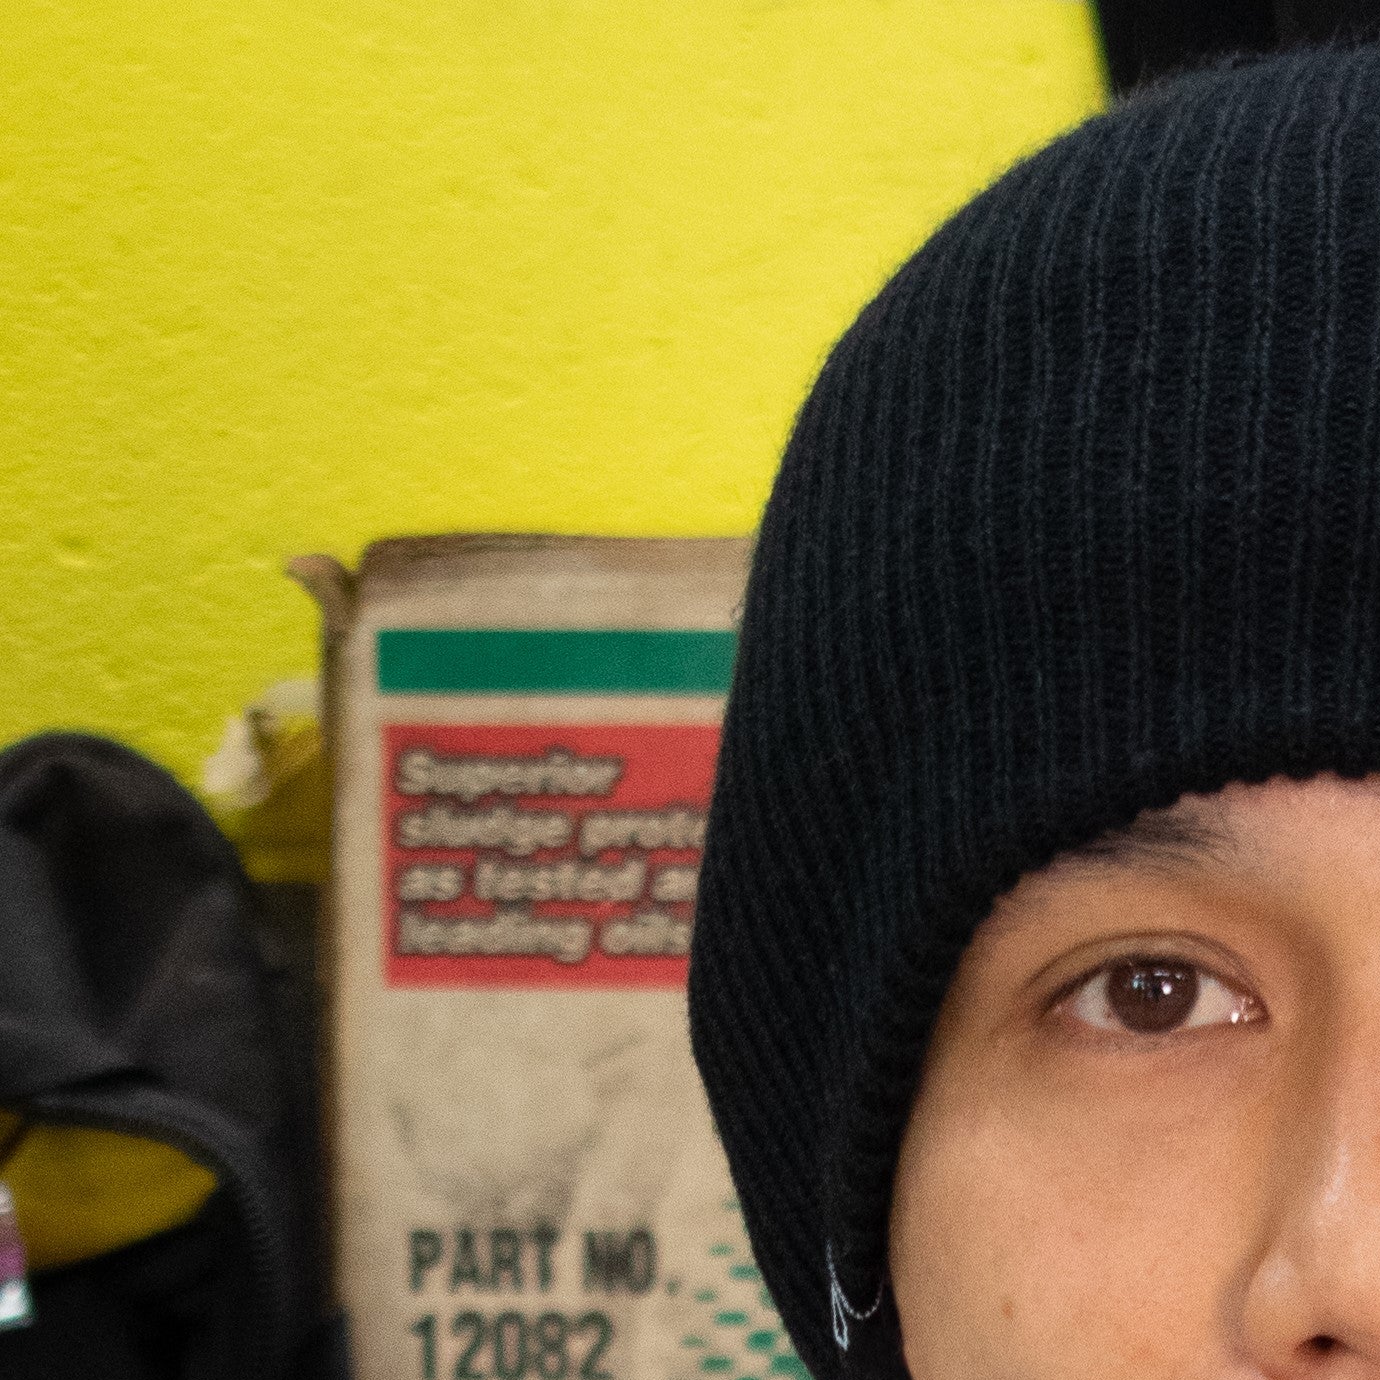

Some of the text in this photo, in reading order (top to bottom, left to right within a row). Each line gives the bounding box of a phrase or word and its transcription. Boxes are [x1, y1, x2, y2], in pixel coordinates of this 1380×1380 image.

[400, 748, 623, 801] Superior
[400, 807, 706, 856] sludge prote
[399, 858, 699, 902] as tested a
[400, 912, 592, 964] leading
[407, 1225, 682, 1298] PART NO.
